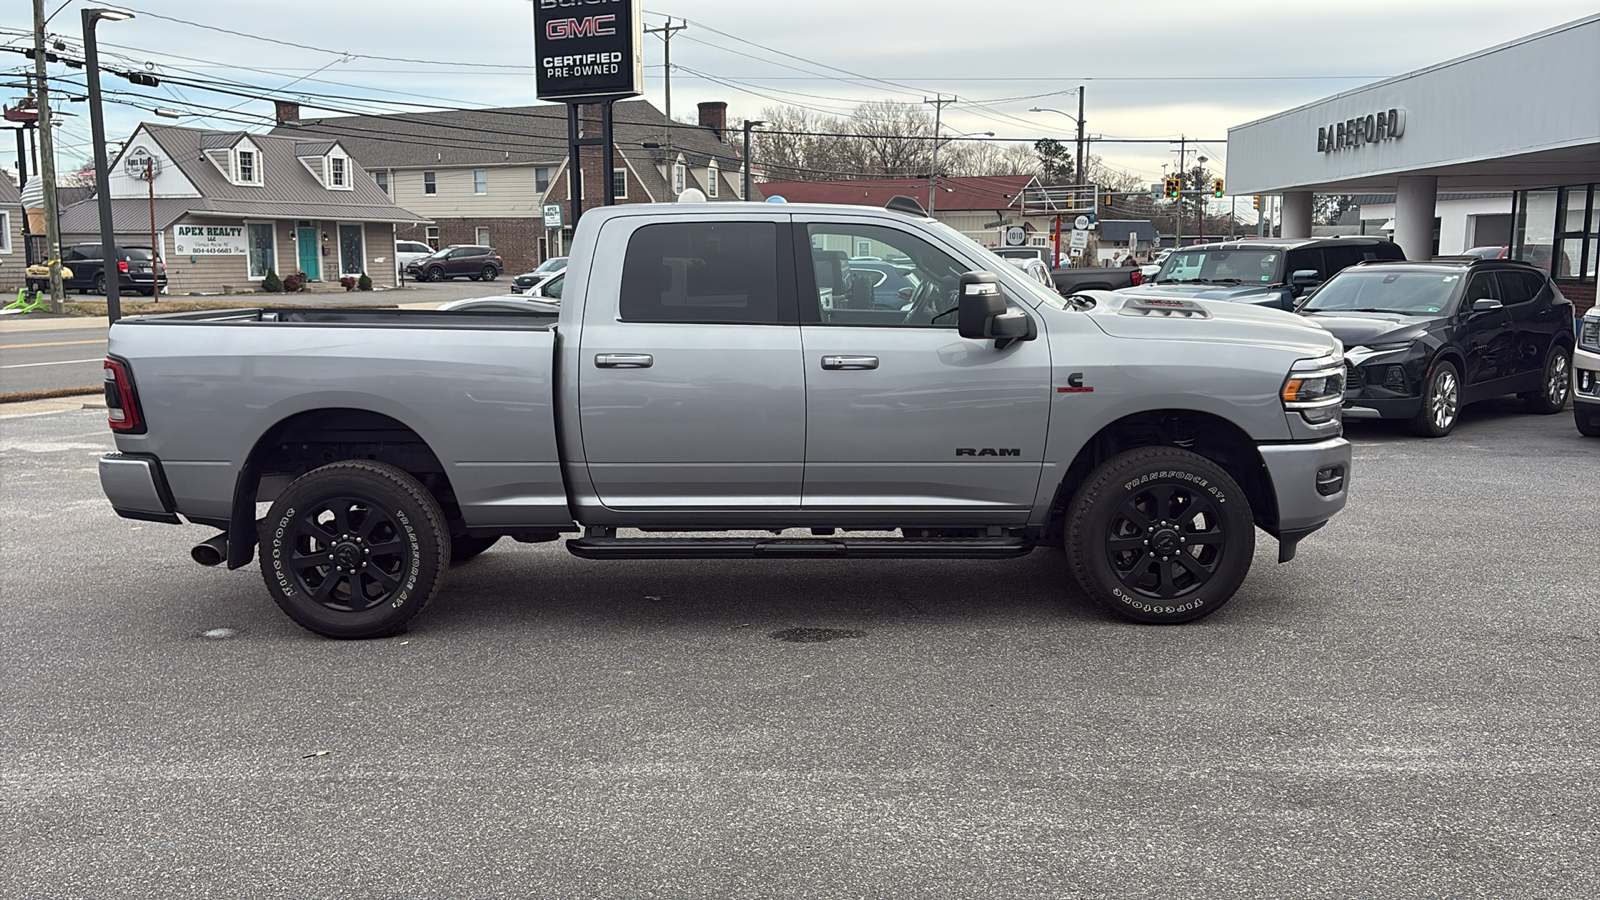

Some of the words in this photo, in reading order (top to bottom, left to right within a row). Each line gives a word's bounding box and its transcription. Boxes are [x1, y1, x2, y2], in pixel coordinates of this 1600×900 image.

[546, 14, 616, 40] GMC
[543, 52, 622, 67] CERTIFIED
[547, 64, 618, 78] PRE-OWNED
[1317, 108, 1406, 153] BAREFORD
[179, 227, 204, 236] APEX
[207, 227, 242, 237] REALTY
[1009, 232, 1023, 240] 1010
[956, 448, 1021, 456] RAM
[1124, 470, 1208, 491] TRANSFORCE
[272, 507, 297, 598] Firestone
[396, 509, 420, 590] TRANSFORCE
[1112, 587, 1204, 614] Firestone
